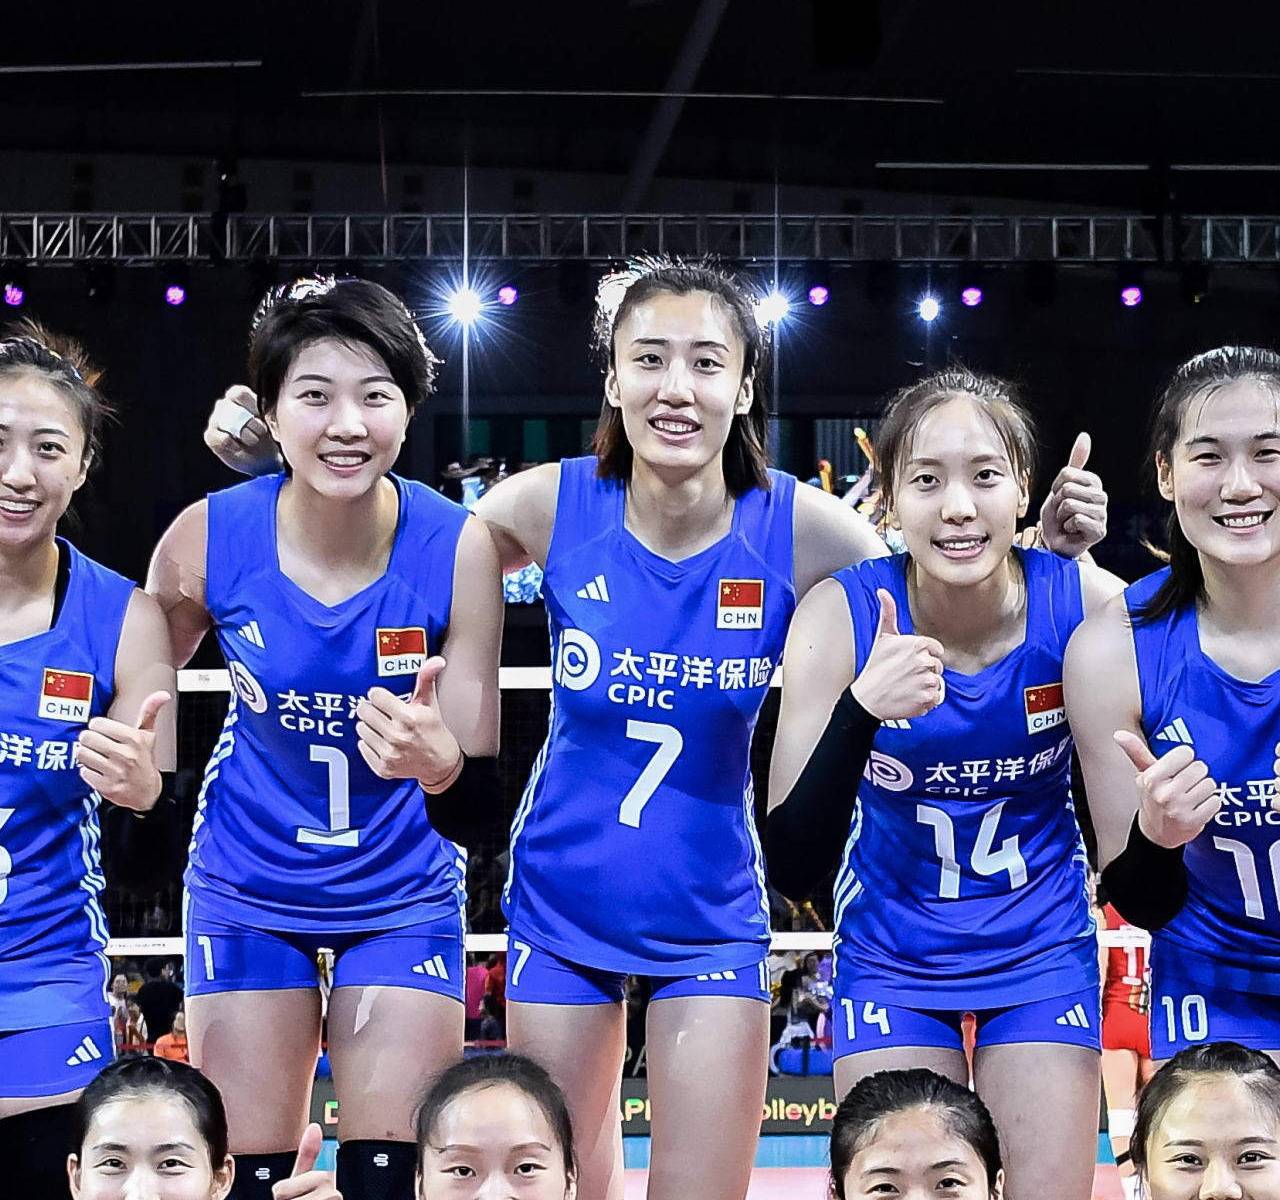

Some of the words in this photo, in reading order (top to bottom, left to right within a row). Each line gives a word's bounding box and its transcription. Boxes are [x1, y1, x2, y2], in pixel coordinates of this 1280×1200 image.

[723, 611, 758, 625] CHN
[384, 657, 424, 673] CHN
[610, 646, 773, 691] 太平洋保险
[45, 700, 84, 718] CHN
[608, 682, 675, 711] CPIC
[278, 712, 344, 737] CPIC
[1032, 708, 1066, 731] CHN
[296, 744, 359, 848] 1
[618, 719, 684, 829] 7
[924, 785, 990, 797] CPIC
[917, 799, 1028, 900] 14
[196, 934, 216, 982] 1
[510, 938, 532, 988] 7
[841, 996, 893, 1041] 14
[1161, 993, 1208, 1042] 10
